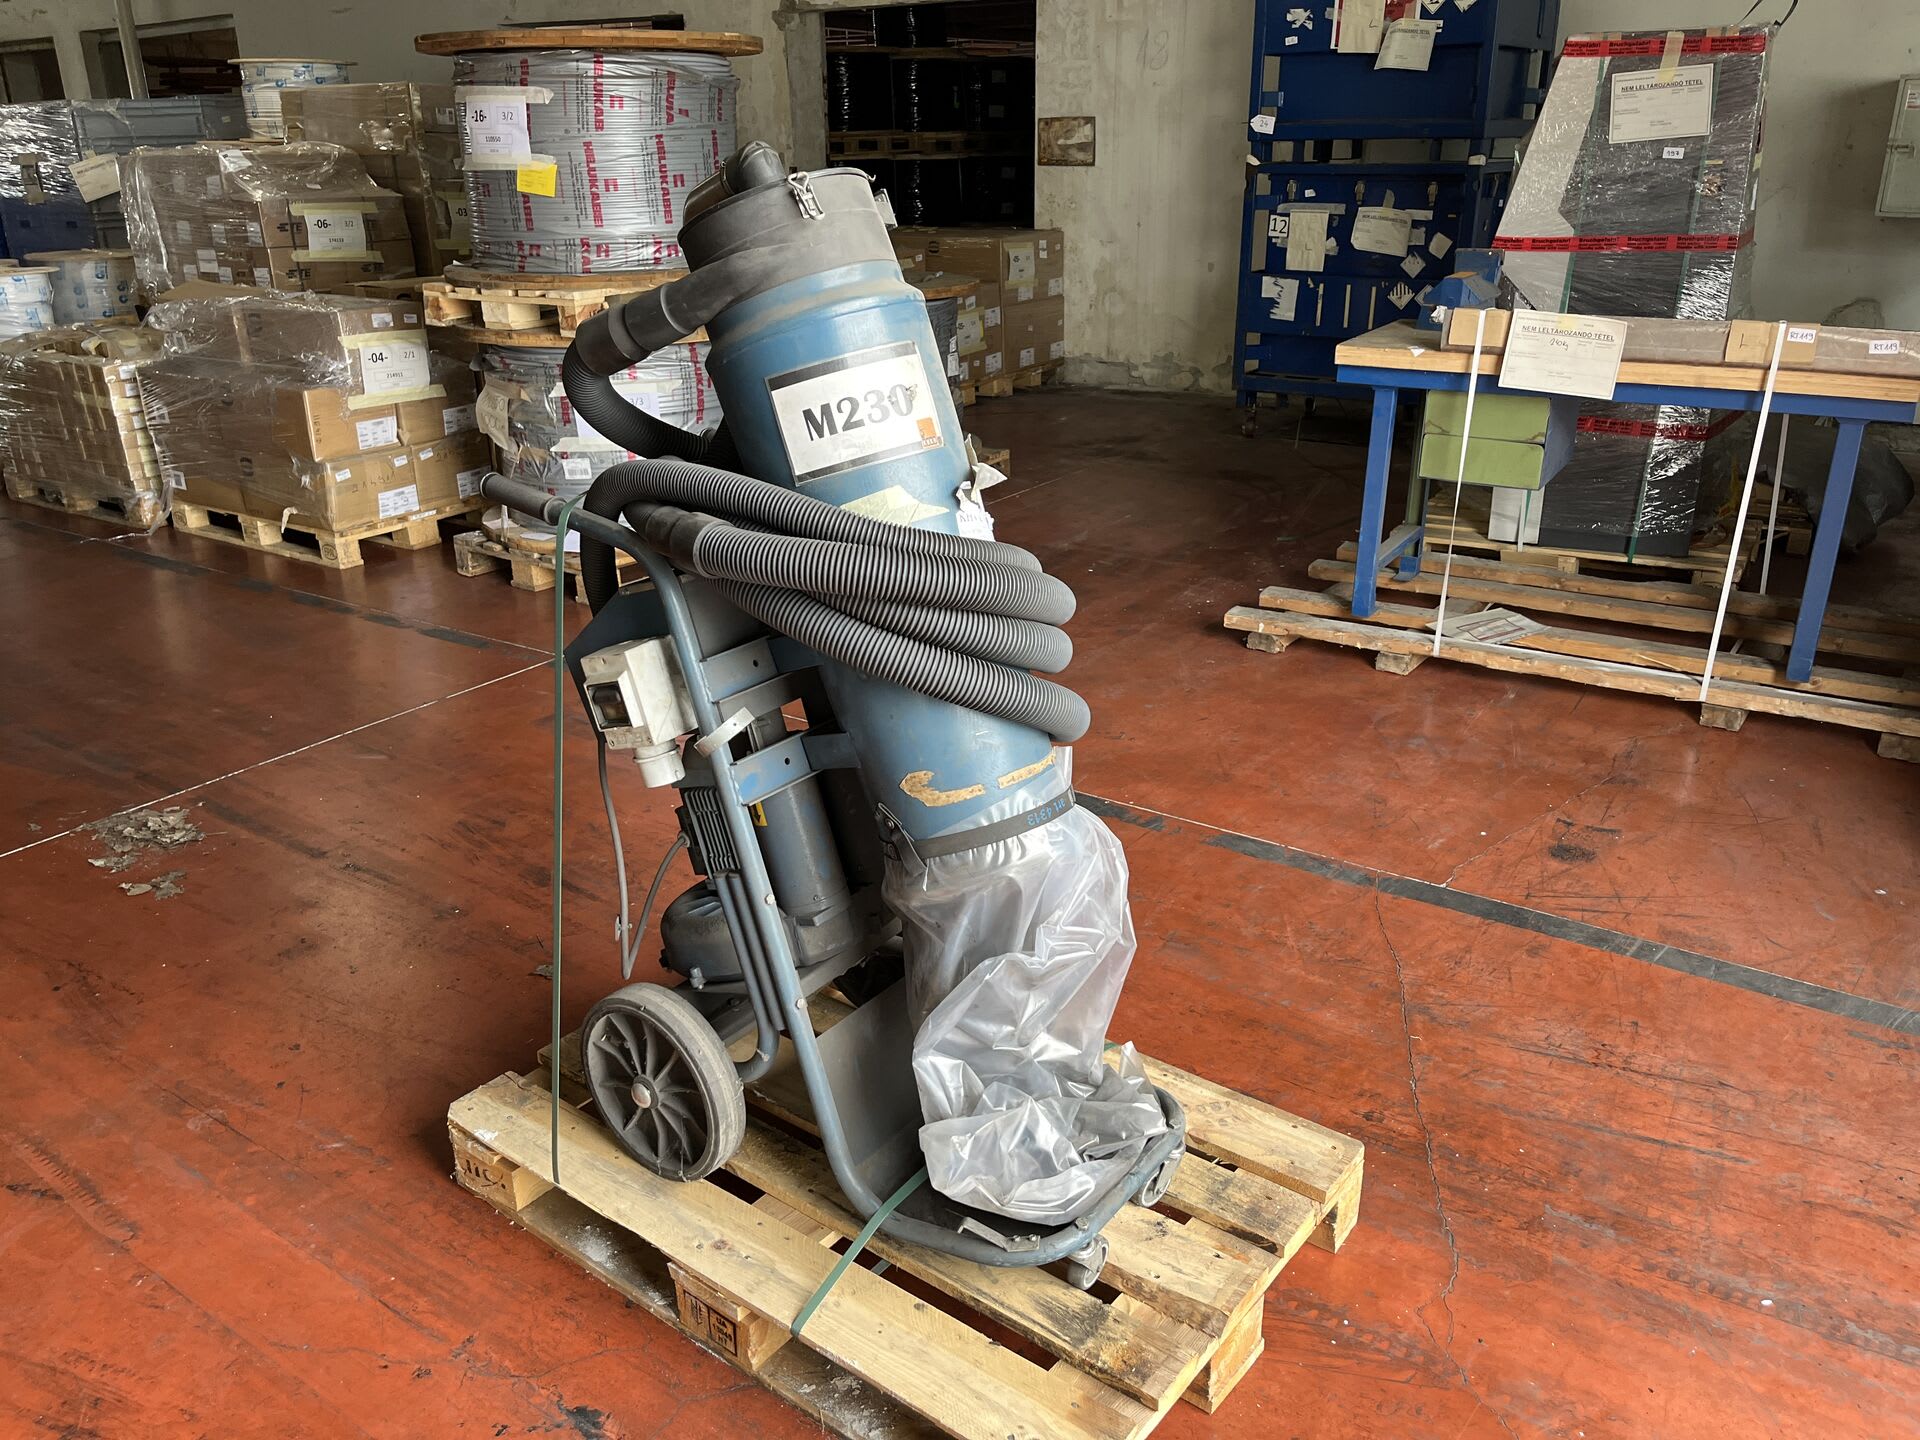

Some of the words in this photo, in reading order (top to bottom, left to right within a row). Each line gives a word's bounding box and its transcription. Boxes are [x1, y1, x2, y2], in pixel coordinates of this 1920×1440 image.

[471, 109, 487, 123] -16-
[501, 111, 514, 121] 3/2
[313, 219, 331, 229] -06-
[1270, 217, 1287, 234] 12
[1521, 325, 1537, 333] NEM
[367, 352, 389, 363] -04-
[403, 351, 416, 359] 2/1
[802, 383, 914, 442] M230
